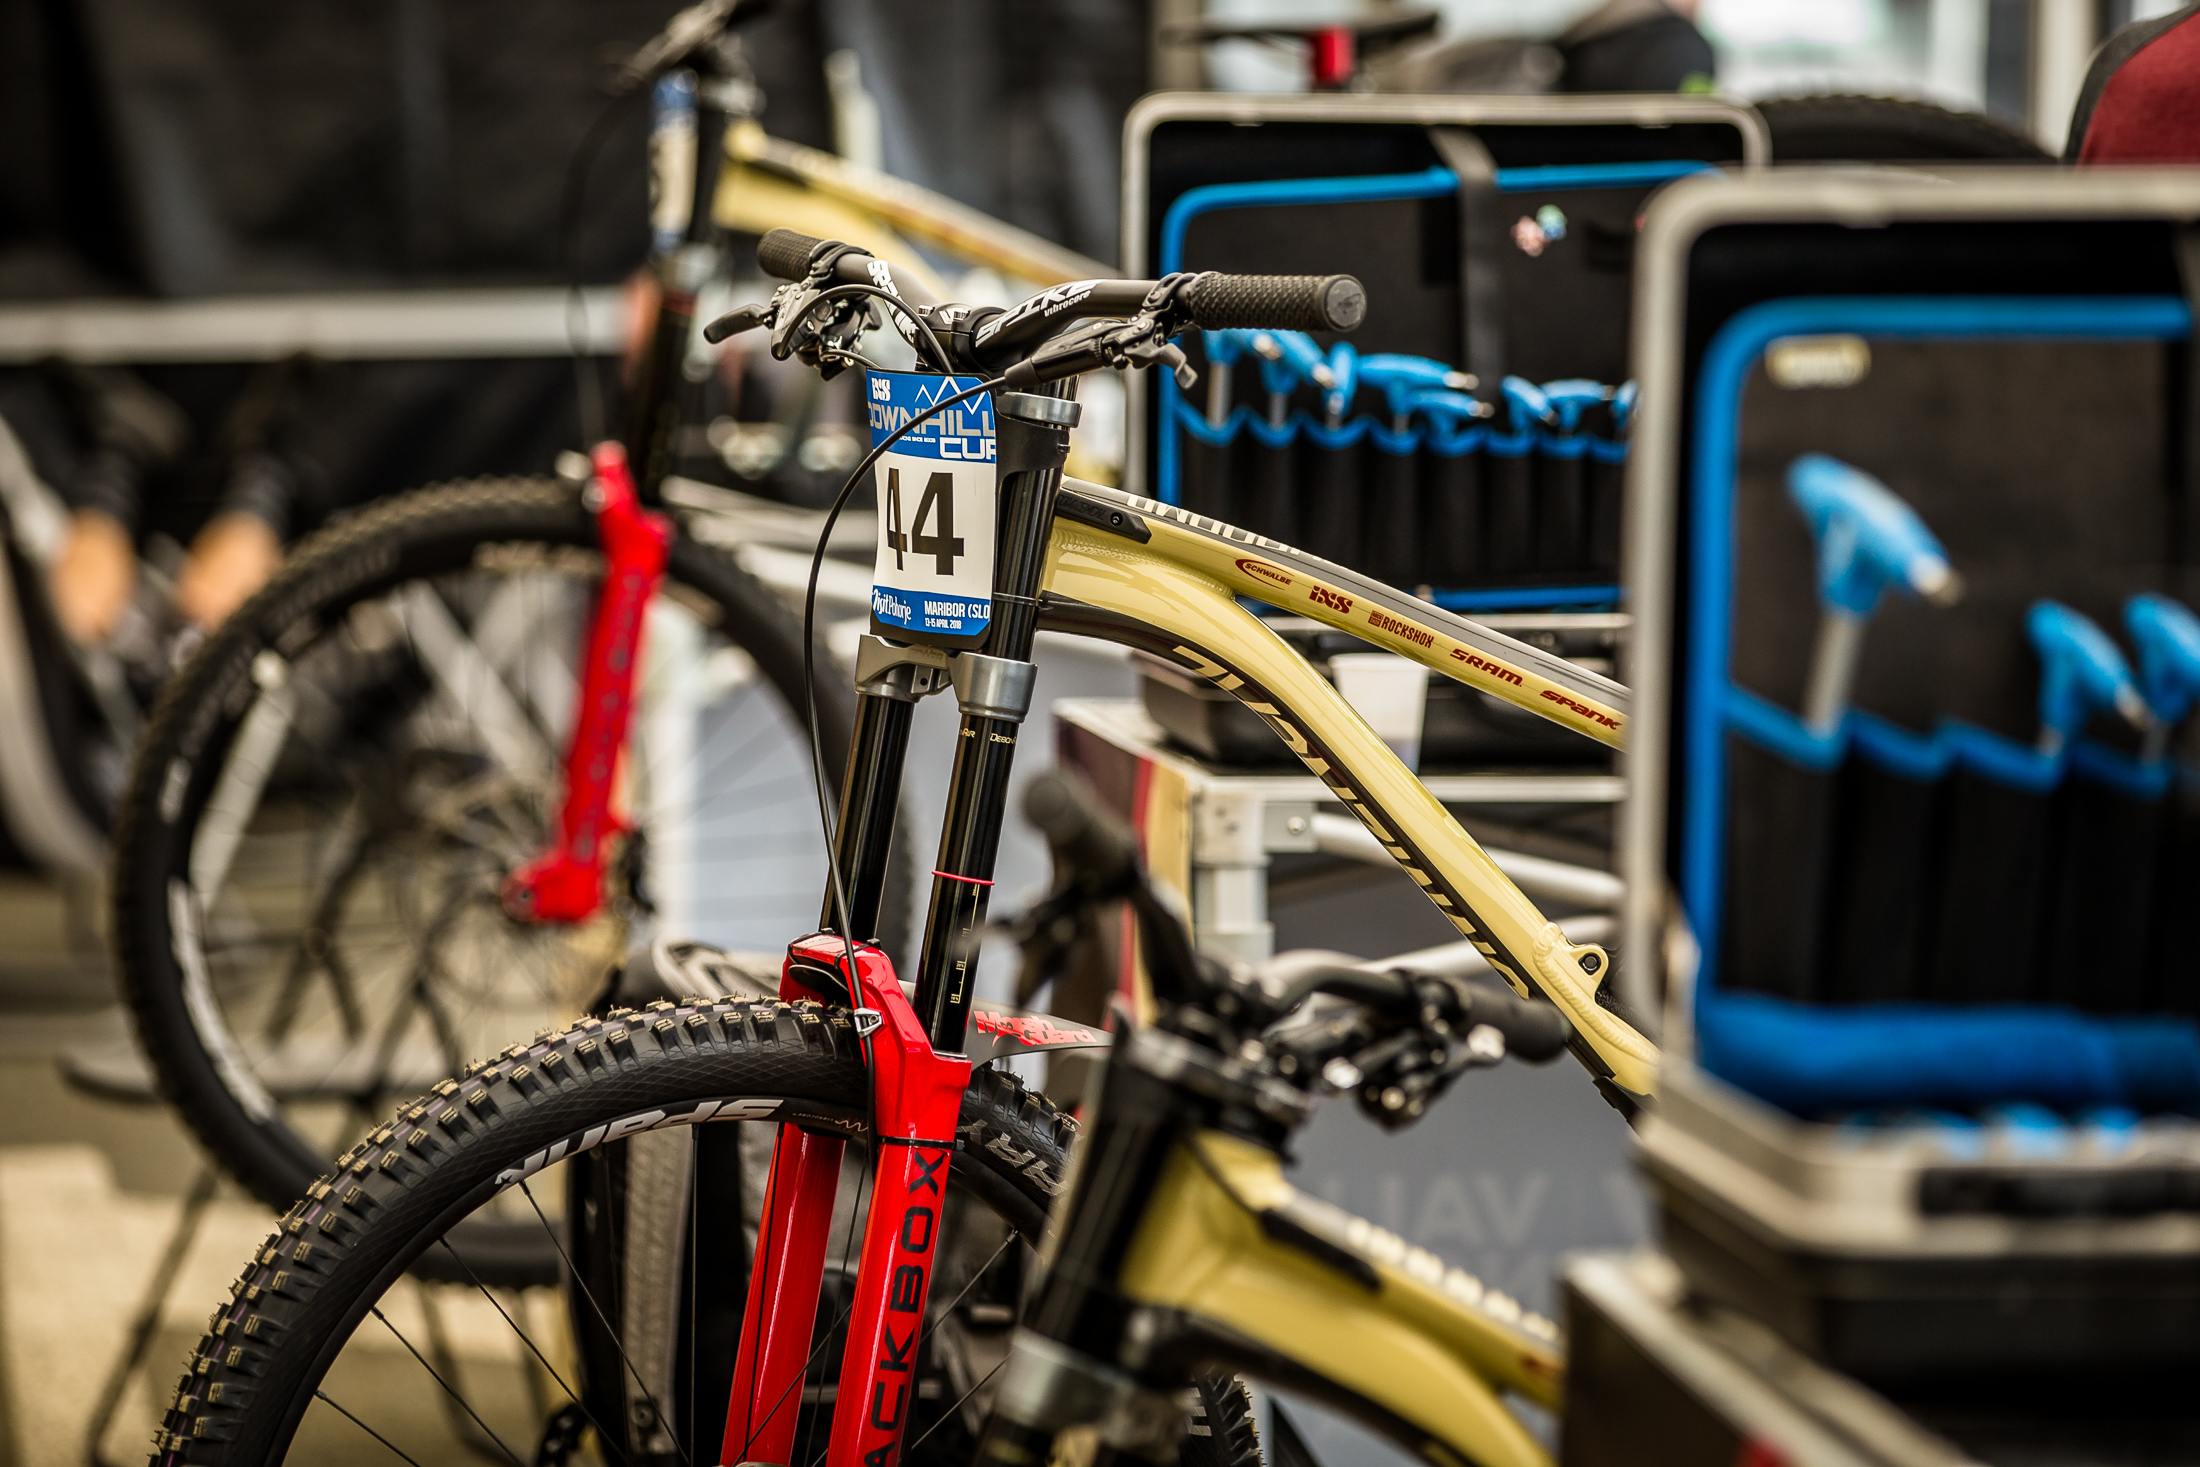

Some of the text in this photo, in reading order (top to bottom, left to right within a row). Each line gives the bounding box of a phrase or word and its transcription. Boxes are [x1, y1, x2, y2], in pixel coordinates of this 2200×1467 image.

[975, 280, 1102, 348] SPIKE
[887, 467, 965, 576] 44
[1245, 563, 1292, 585] SCHWALBE
[889, 595, 912, 625] Pohorje
[924, 600, 966, 618] MARIBOR
[936, 618, 949, 629] APRIL
[1381, 616, 1435, 649] ROCKSHOX
[1450, 649, 1523, 687] SRAM
